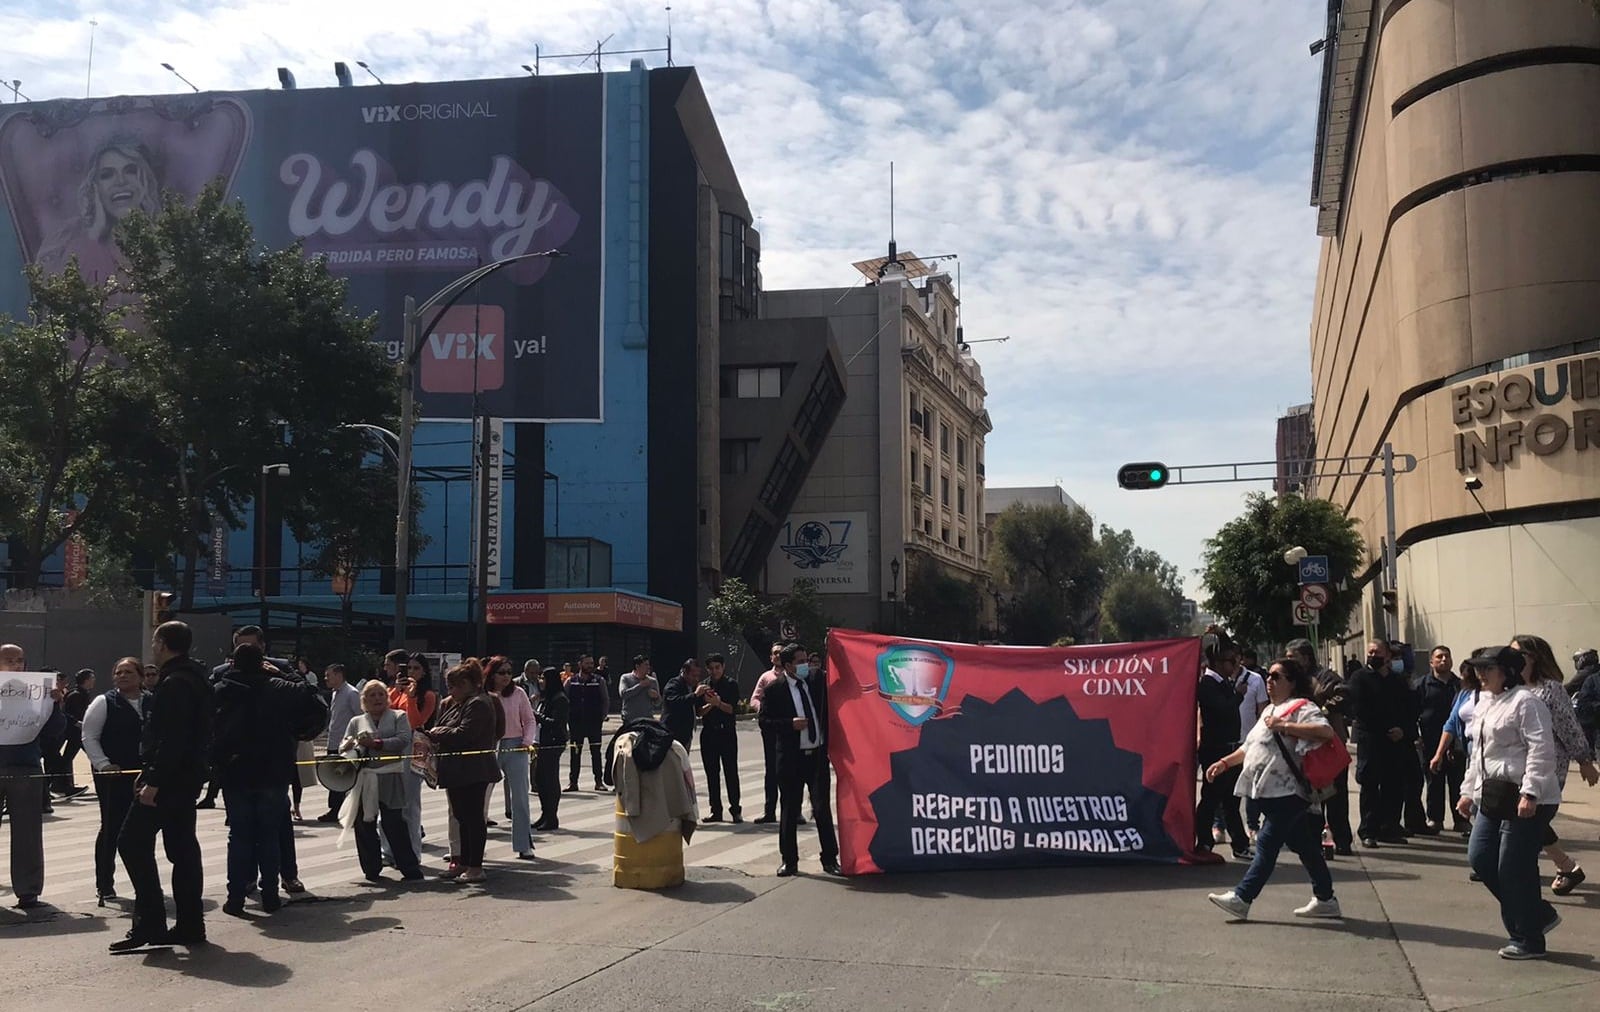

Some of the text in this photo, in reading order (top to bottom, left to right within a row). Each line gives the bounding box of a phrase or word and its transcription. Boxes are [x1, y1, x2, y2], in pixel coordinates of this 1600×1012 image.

[361, 102, 496, 123] ViX ORIGINAL
[280, 150, 557, 264] Wendy
[375, 249, 414, 262] PERO
[417, 247, 478, 261] FAMOSA
[429, 332, 497, 360] ViX
[513, 335, 547, 359] ya!
[1064, 654, 1169, 676] SECCIÓN 1
[1082, 678, 1147, 697] CDMX
[970, 744, 1065, 774] PEDIMOS
[912, 793, 1128, 824] RESPETO A NUESTROS
[911, 825, 1144, 855] DERECHOS LABORALES
